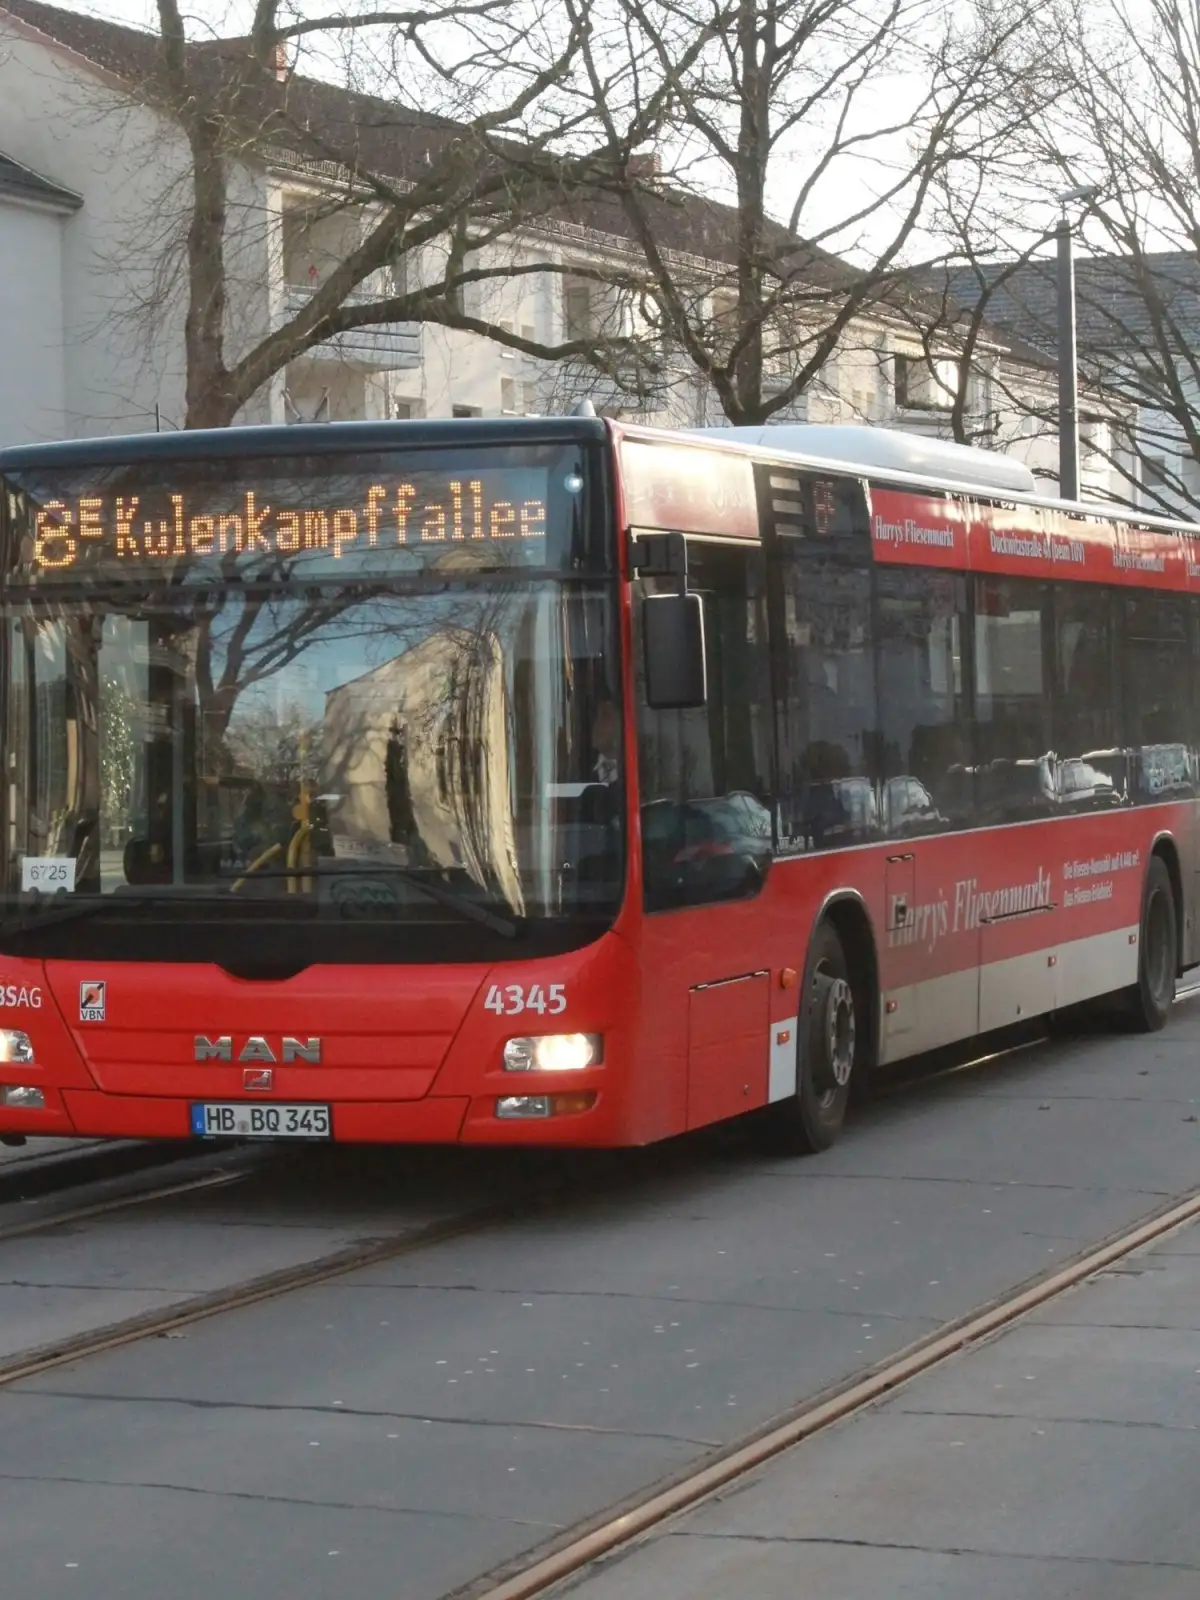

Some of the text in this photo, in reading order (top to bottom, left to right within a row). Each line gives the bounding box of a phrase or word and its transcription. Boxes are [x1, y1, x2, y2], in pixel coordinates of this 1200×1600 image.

[116, 481, 546, 558] Kulenkampffallee
[876, 514, 954, 548] Harry's Fliesenmarkt
[30, 865, 67, 880] 6725
[888, 866, 1053, 953] Harry's Fliesenmarkt
[484, 983, 567, 1015] 4345
[81, 1009, 104, 1021] VBN
[193, 1035, 321, 1063] MAN
[206, 1107, 235, 1131] HB
[251, 1108, 279, 1132] BQ
[286, 1108, 328, 1133] 345
